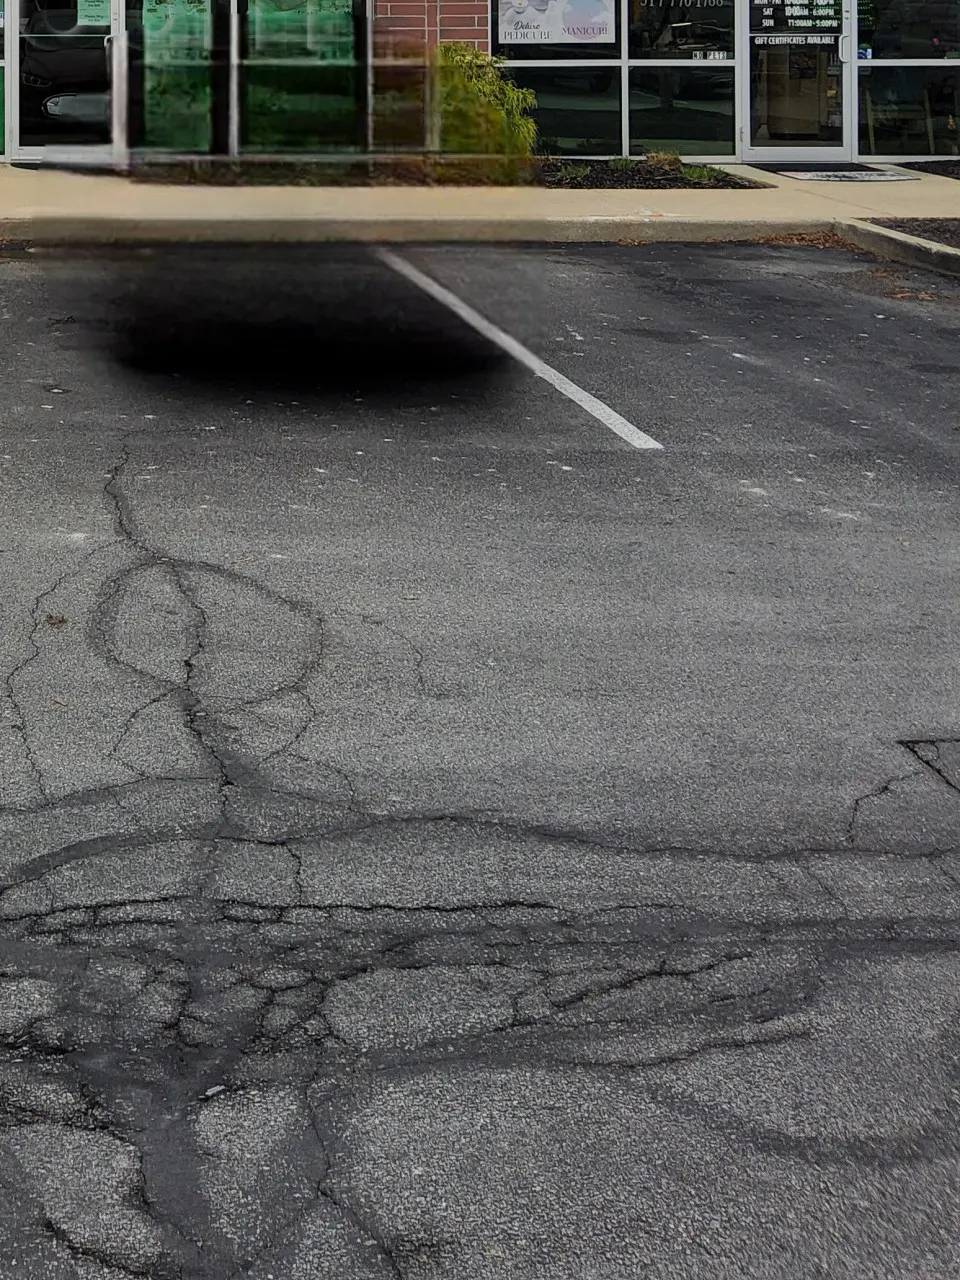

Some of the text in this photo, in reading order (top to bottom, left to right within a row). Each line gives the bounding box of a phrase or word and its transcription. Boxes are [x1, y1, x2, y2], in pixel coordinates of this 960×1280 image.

[762, 8, 774, 16] SAT
[762, 19, 775, 27] SUN
[562, 26, 611, 35] MANICURE
[503, 30, 553, 40] PEDICURE
[754, 36, 835, 45] GIFT CERTIFICATES AVAILABLE
[707, 51, 726, 59] PETS
